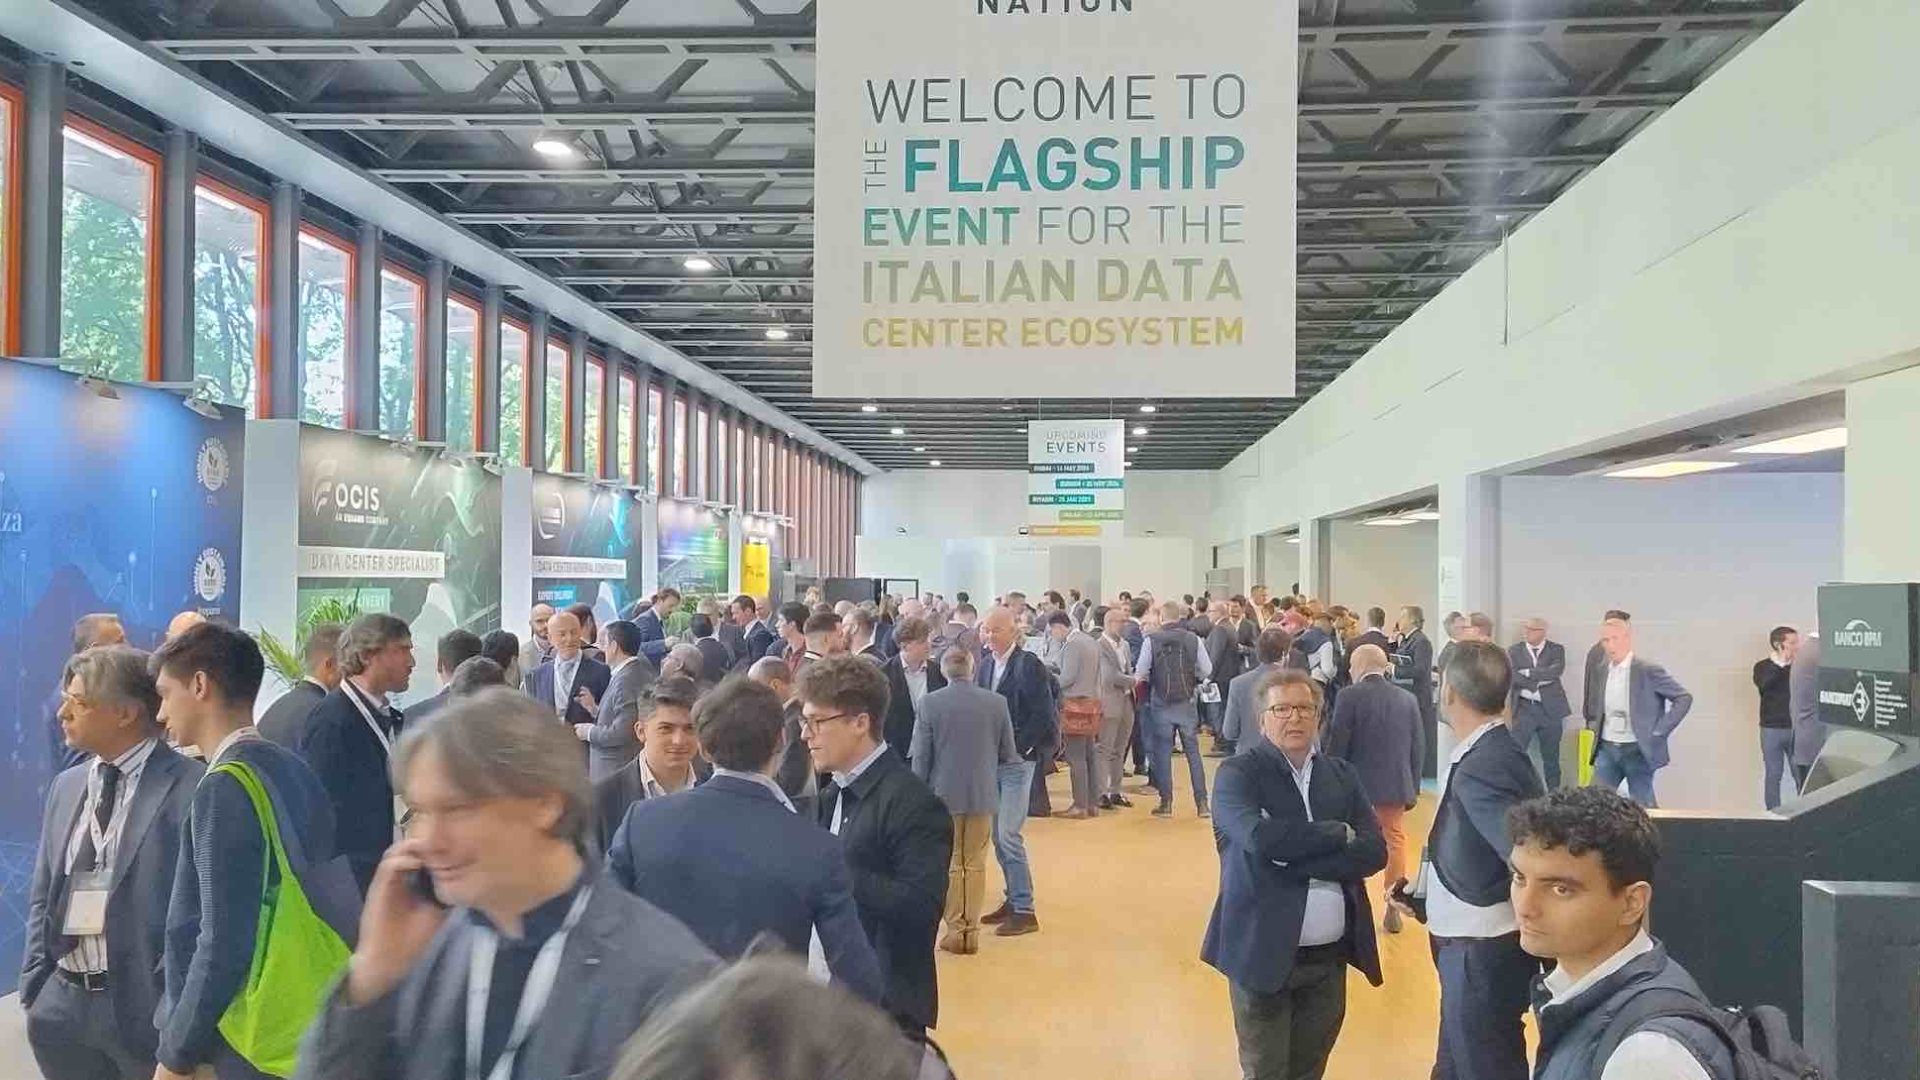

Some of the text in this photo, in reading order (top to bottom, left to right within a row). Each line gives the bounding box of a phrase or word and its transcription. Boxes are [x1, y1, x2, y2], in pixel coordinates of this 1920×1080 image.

[866, 73, 1246, 123] WELCOME TO
[865, 139, 887, 193] THE
[904, 136, 1246, 193] FLAGSHIP
[863, 205, 1246, 247] EVENT FOR THE
[863, 258, 1243, 304] ITALIAN DATA
[862, 316, 1244, 348] CENTER ECOSYSTEM
[1046, 442, 1107, 453] EVENTS
[335, 482, 380, 512] OCIS
[346, 553, 384, 571] CENTER
[388, 554, 441, 571] SPECIALIST
[1834, 631, 1882, 647] BANCO BPM
